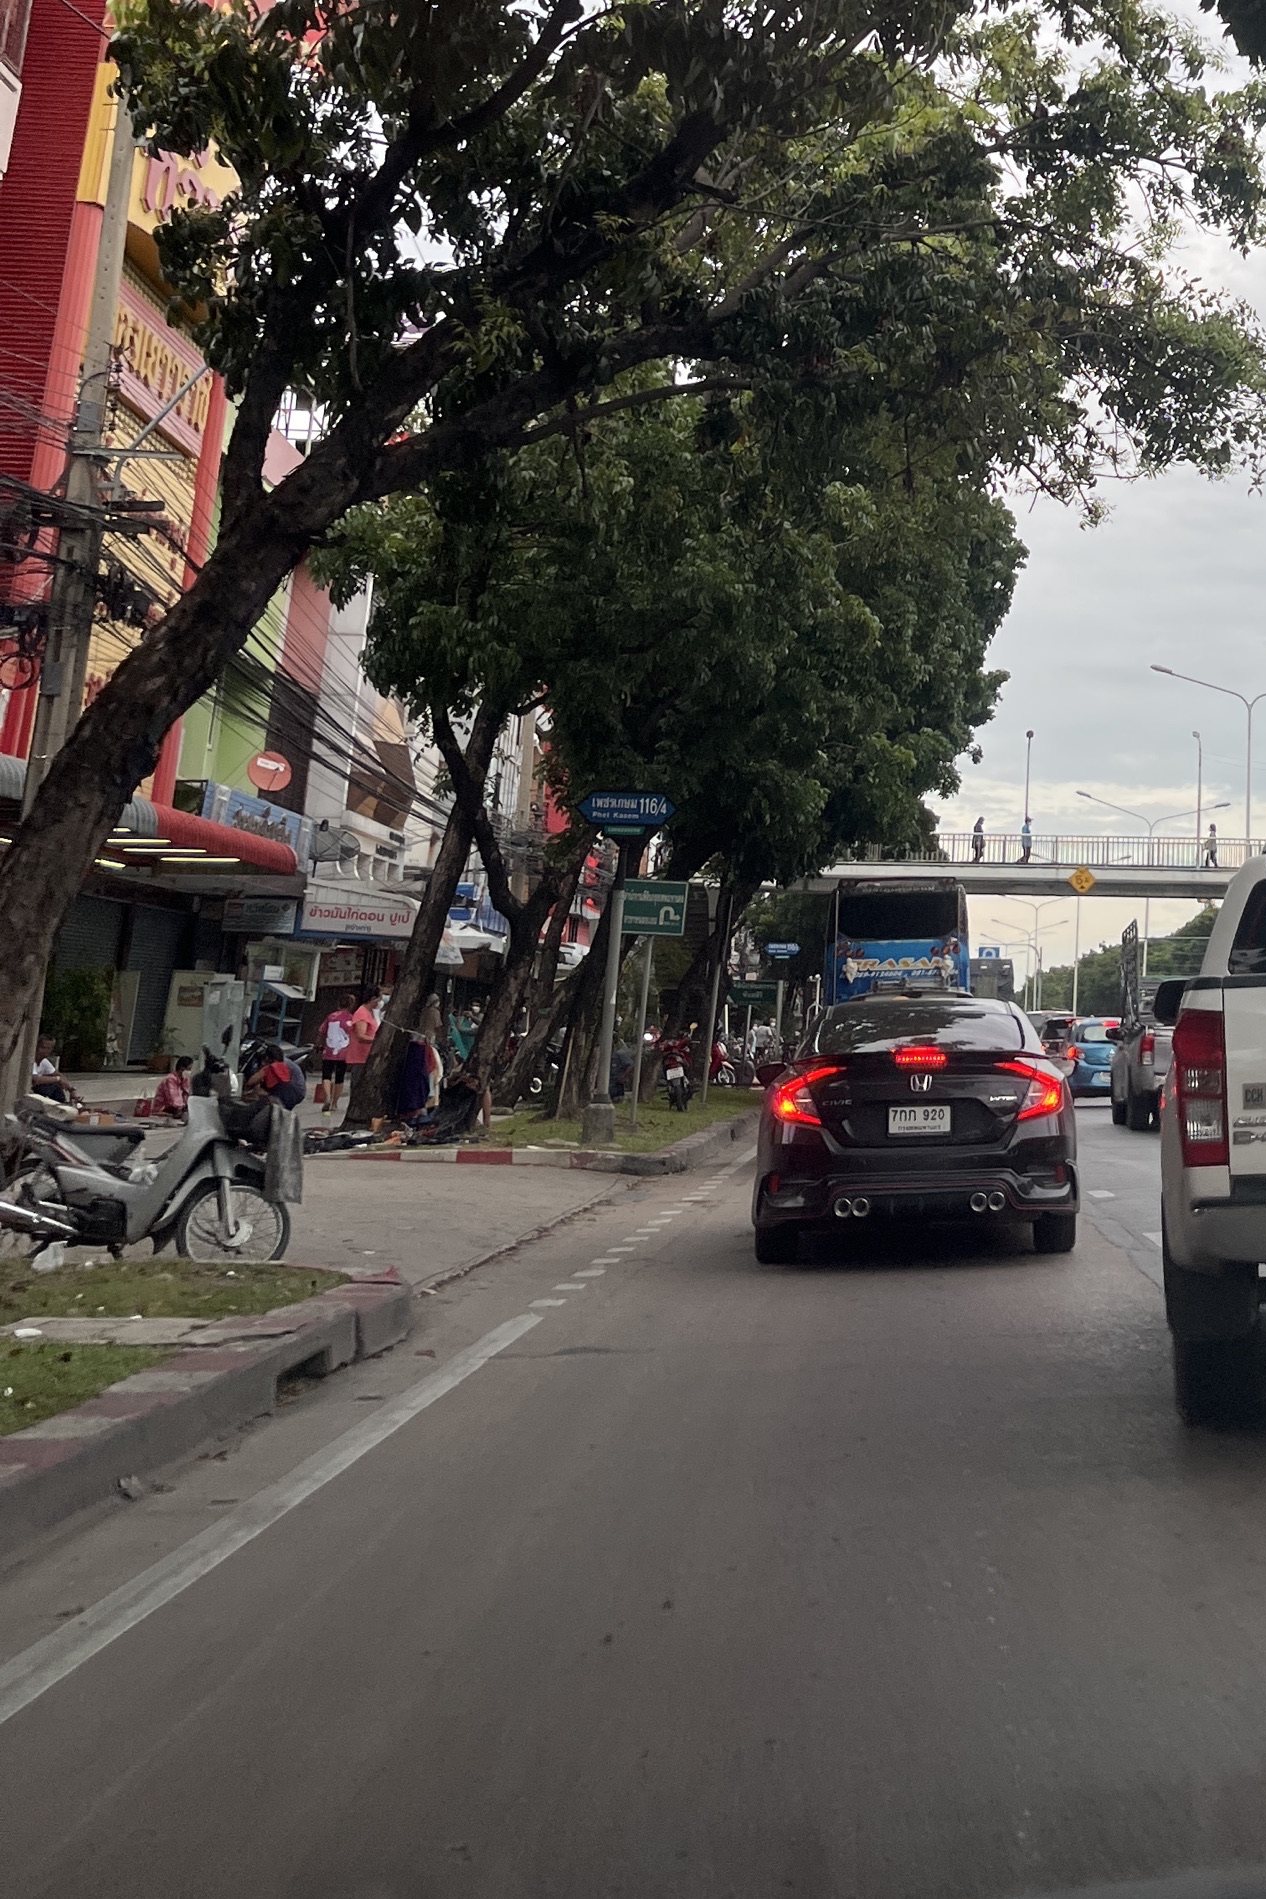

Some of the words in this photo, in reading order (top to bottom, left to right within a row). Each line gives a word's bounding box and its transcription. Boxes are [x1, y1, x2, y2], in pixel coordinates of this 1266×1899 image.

[591, 797, 638, 809] เพชรเกษม
[639, 797, 668, 816] 116/4
[612, 811, 640, 819] Kasem
[309, 906, 385, 922] ข้าวมันไก่ตอน
[923, 1108, 945, 1120] 920
